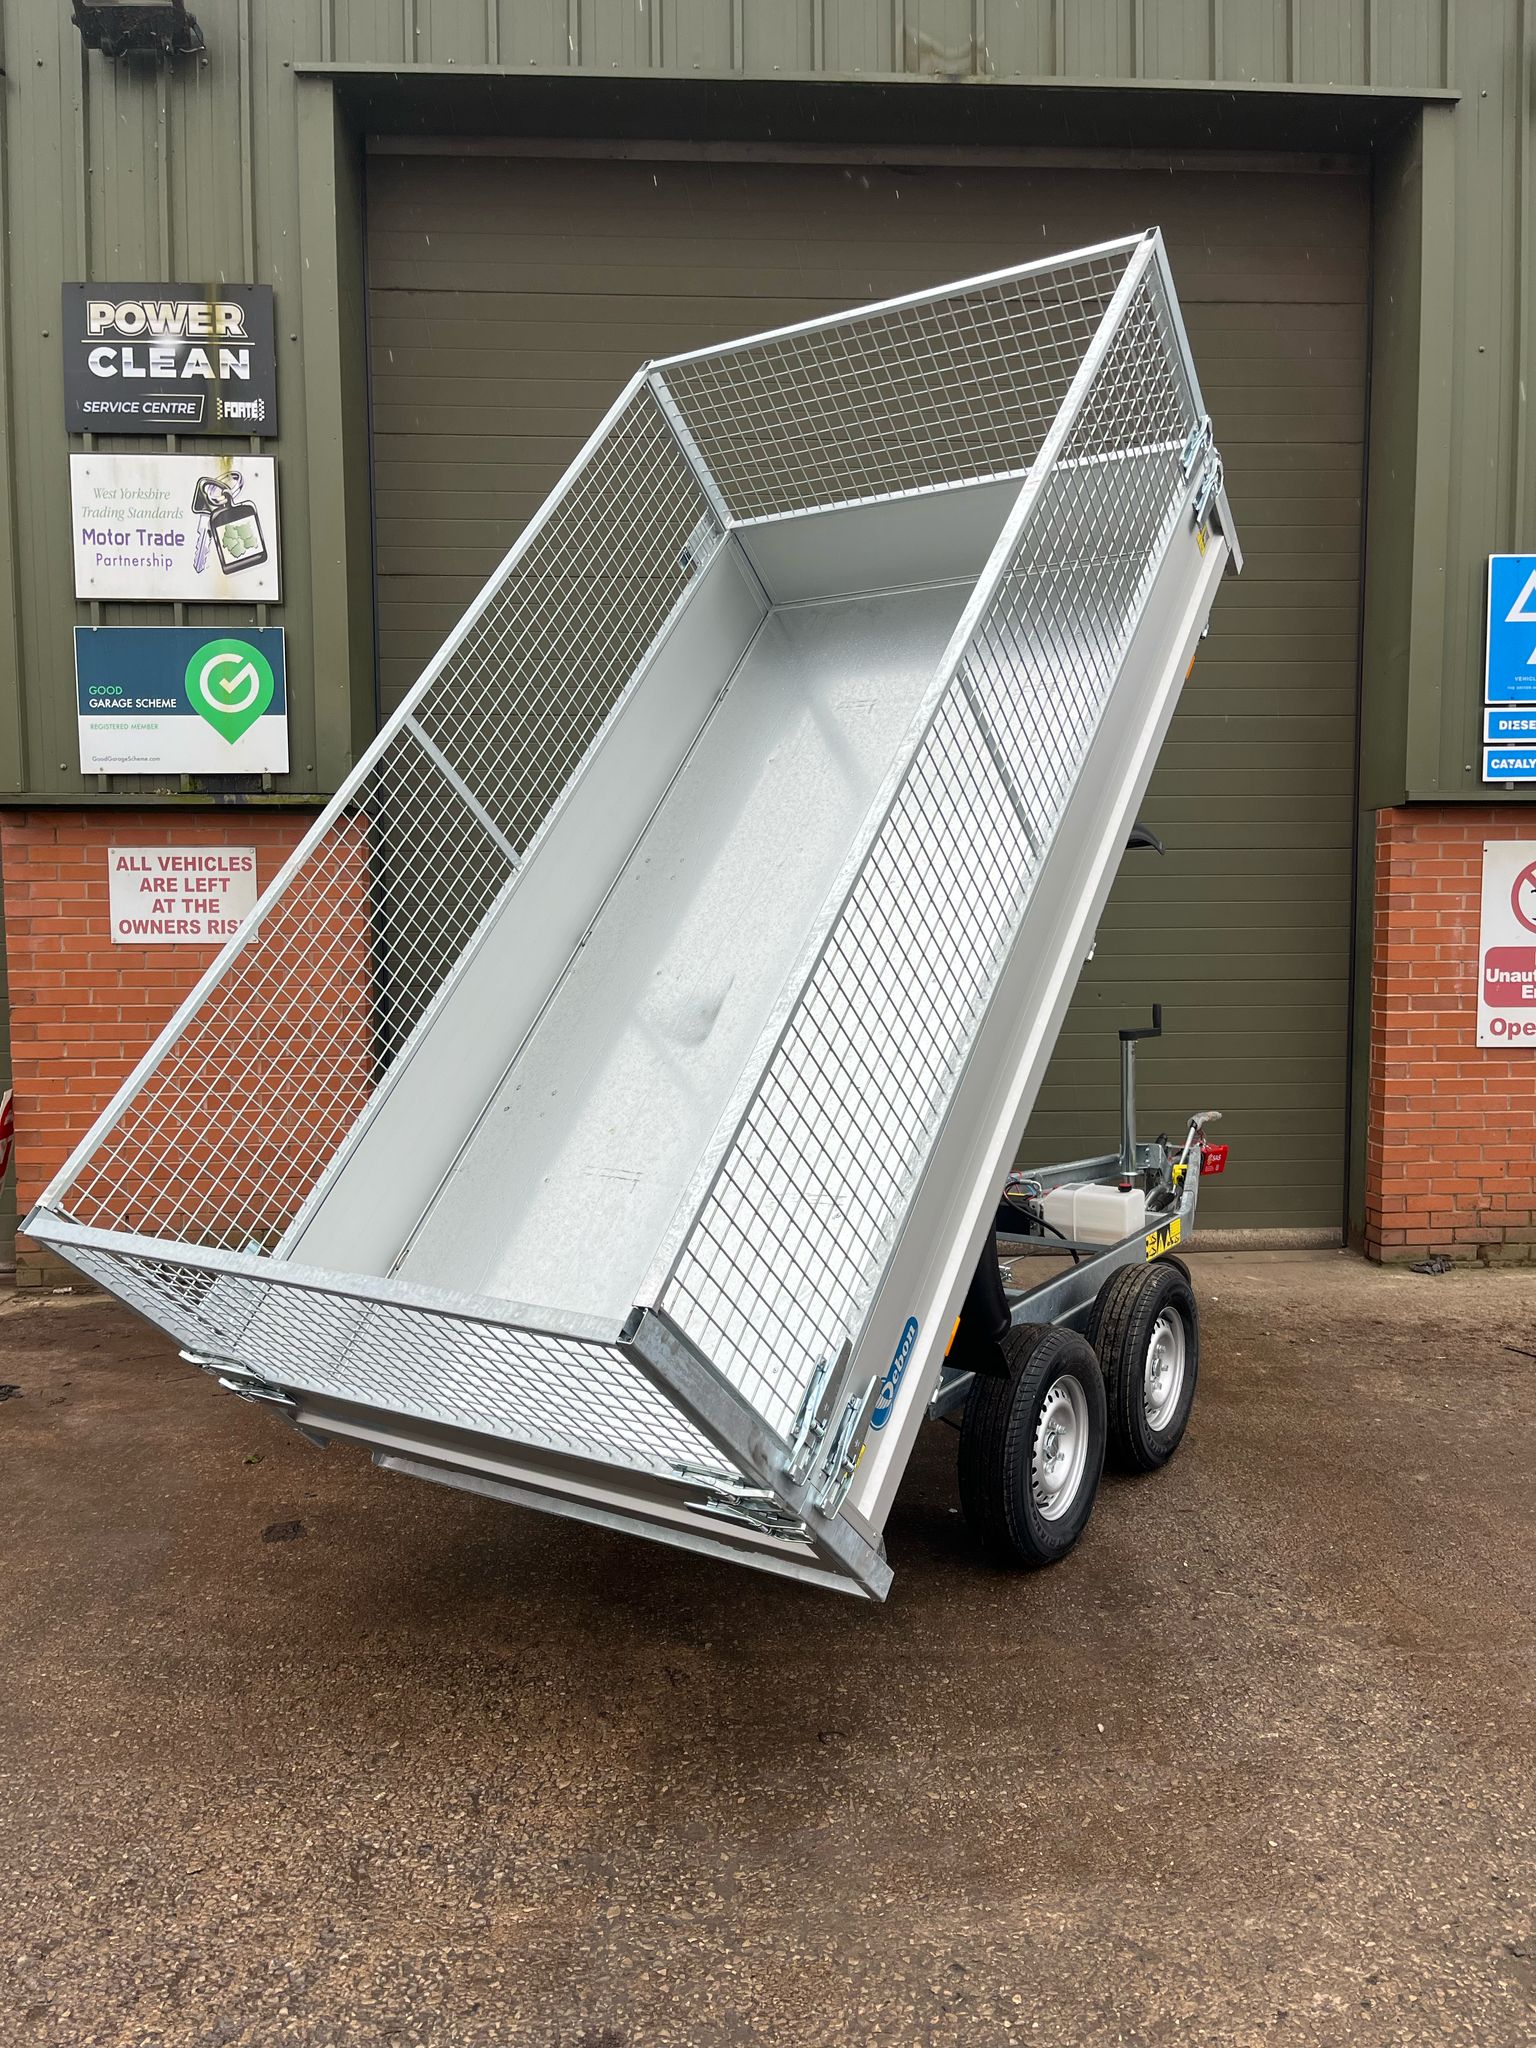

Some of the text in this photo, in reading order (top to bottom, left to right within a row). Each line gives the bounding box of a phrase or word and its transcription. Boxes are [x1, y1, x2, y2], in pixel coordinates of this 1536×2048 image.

[87, 300, 248, 338] POWER
[88, 347, 250, 380] CLEAN
[83, 401, 196, 414] SERVICE CENTRE
[94, 488, 171, 500] West Yorkshire
[82, 506, 184, 521] Trading Standards
[82, 528, 185, 546] Motor Trade
[96, 552, 173, 571] Partnership
[89, 686, 123, 695] GOOD
[89, 698, 177, 708] GARAGE SCHEME
[1499, 720, 1536, 730] DIESE
[116, 856, 253, 872] ALL VEHICLES
[140, 877, 231, 892] ARE LEFT
[152, 898, 221, 913] AT THE
[119, 919, 201, 935] OWNERS
[879, 1324, 916, 1402] Debon
